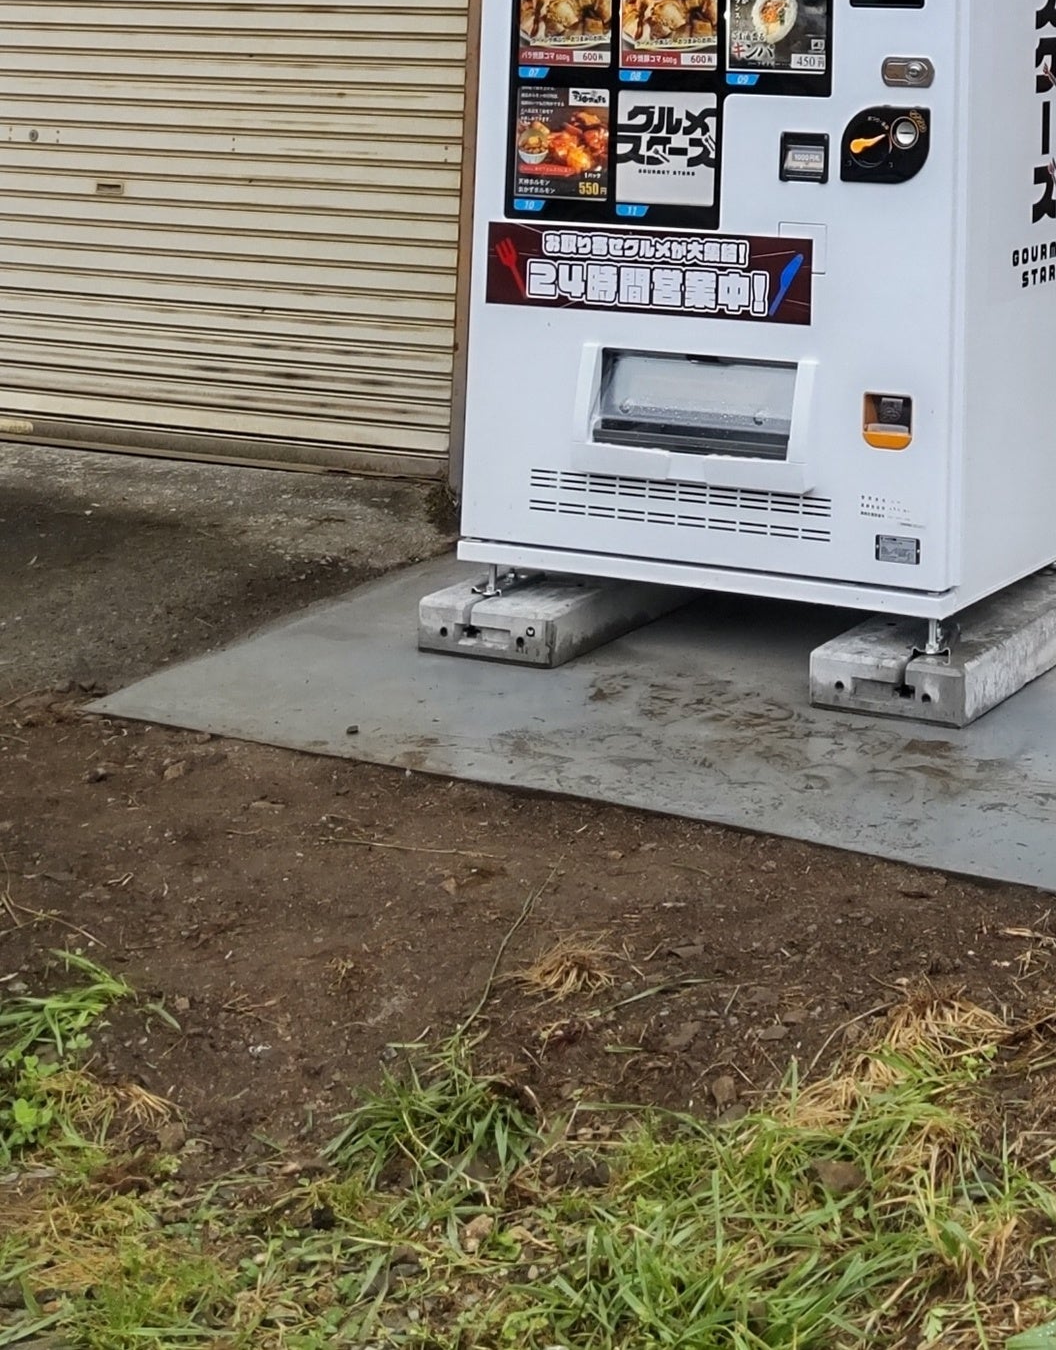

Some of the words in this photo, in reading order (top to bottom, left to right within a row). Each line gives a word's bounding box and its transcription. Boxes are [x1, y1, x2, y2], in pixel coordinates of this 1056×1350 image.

[732, 41, 776, 60] キンパ
[737, 74, 749, 84] 09
[617, 106, 717, 135] グルメ
[578, 181, 608, 196] 550円
[524, 200, 535, 210] 10
[627, 206, 637, 216] 11
[527, 260, 769, 315] 24時間営業中!
